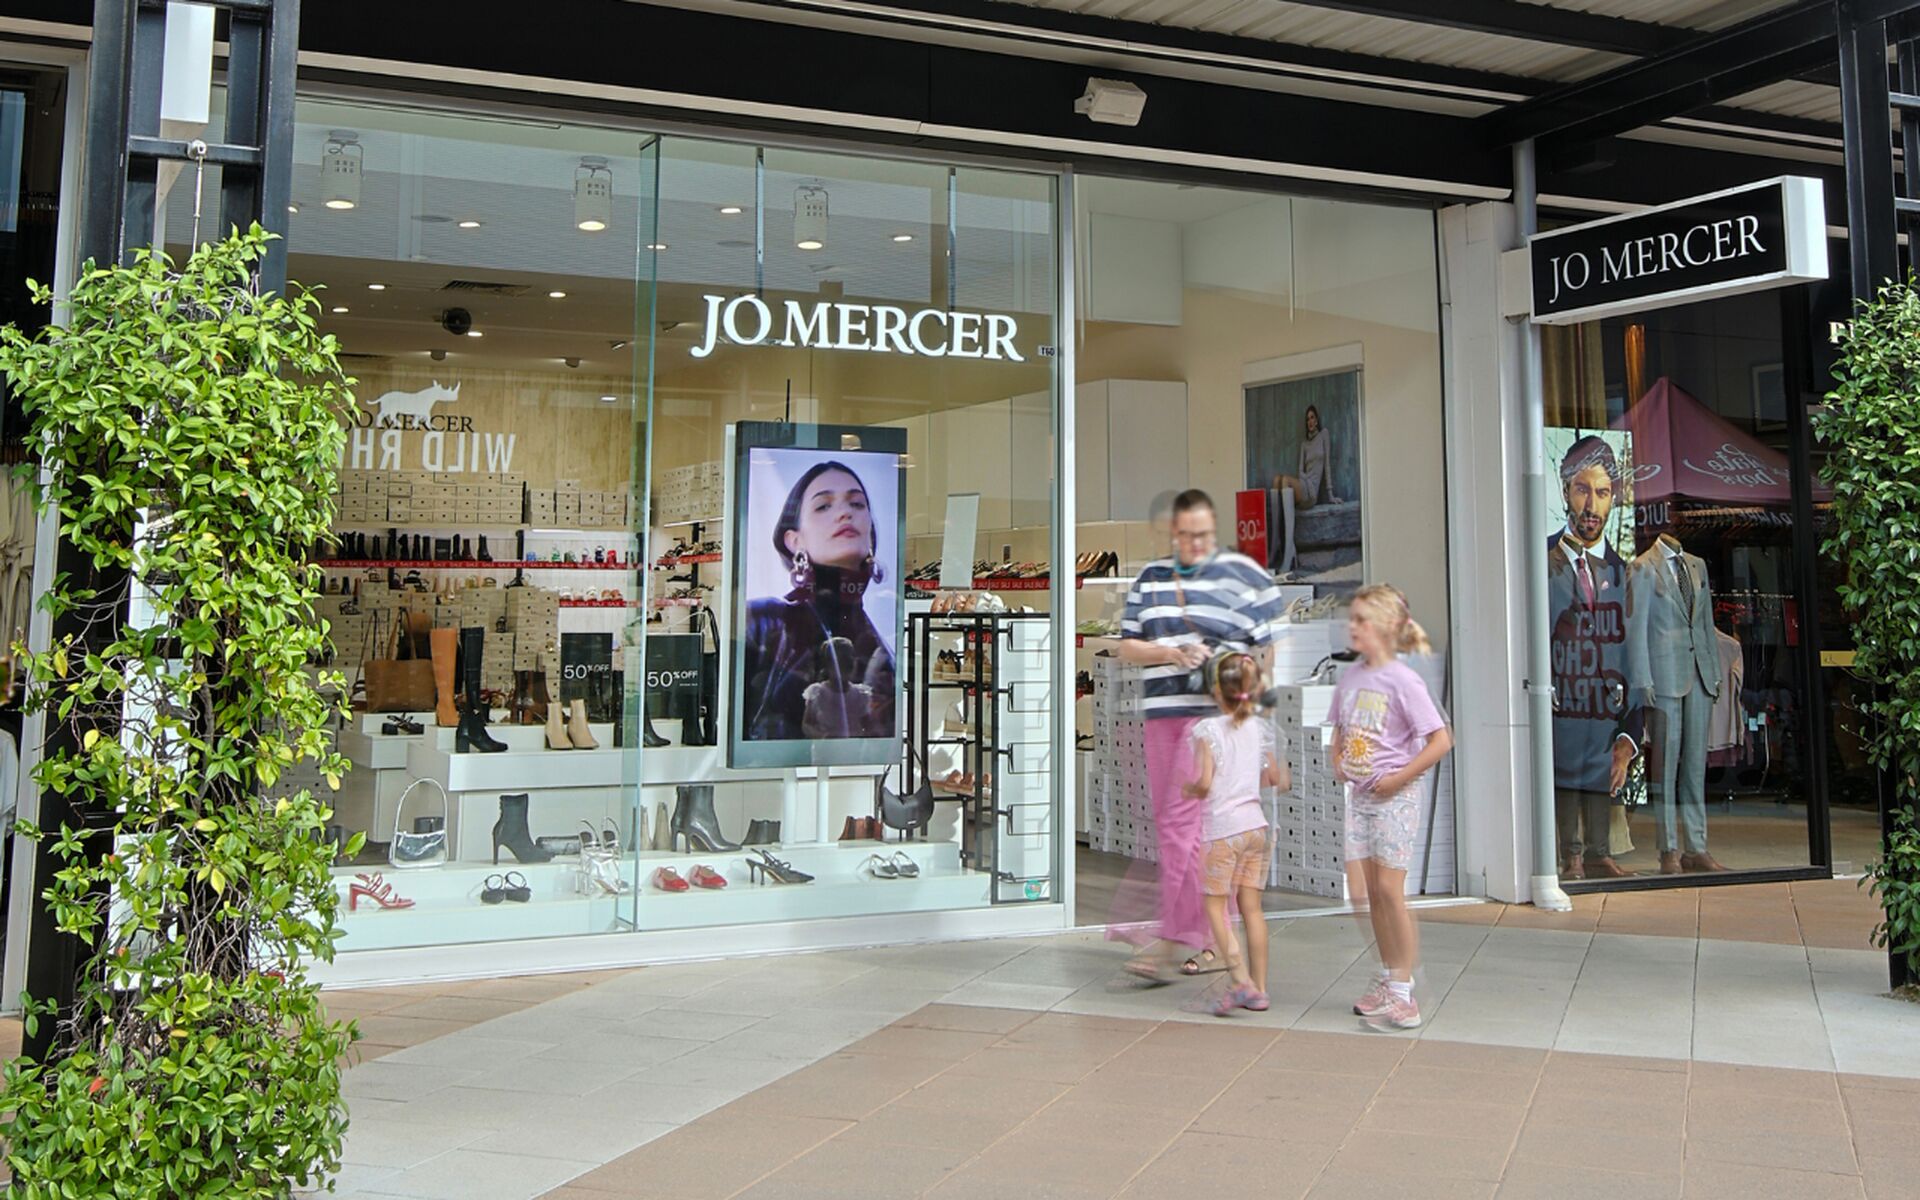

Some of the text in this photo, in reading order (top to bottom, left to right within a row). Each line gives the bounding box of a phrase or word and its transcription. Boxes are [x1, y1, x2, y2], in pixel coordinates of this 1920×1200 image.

[1548, 214, 1766, 304] JO MERCER
[690, 294, 1025, 362] JO MERCER
